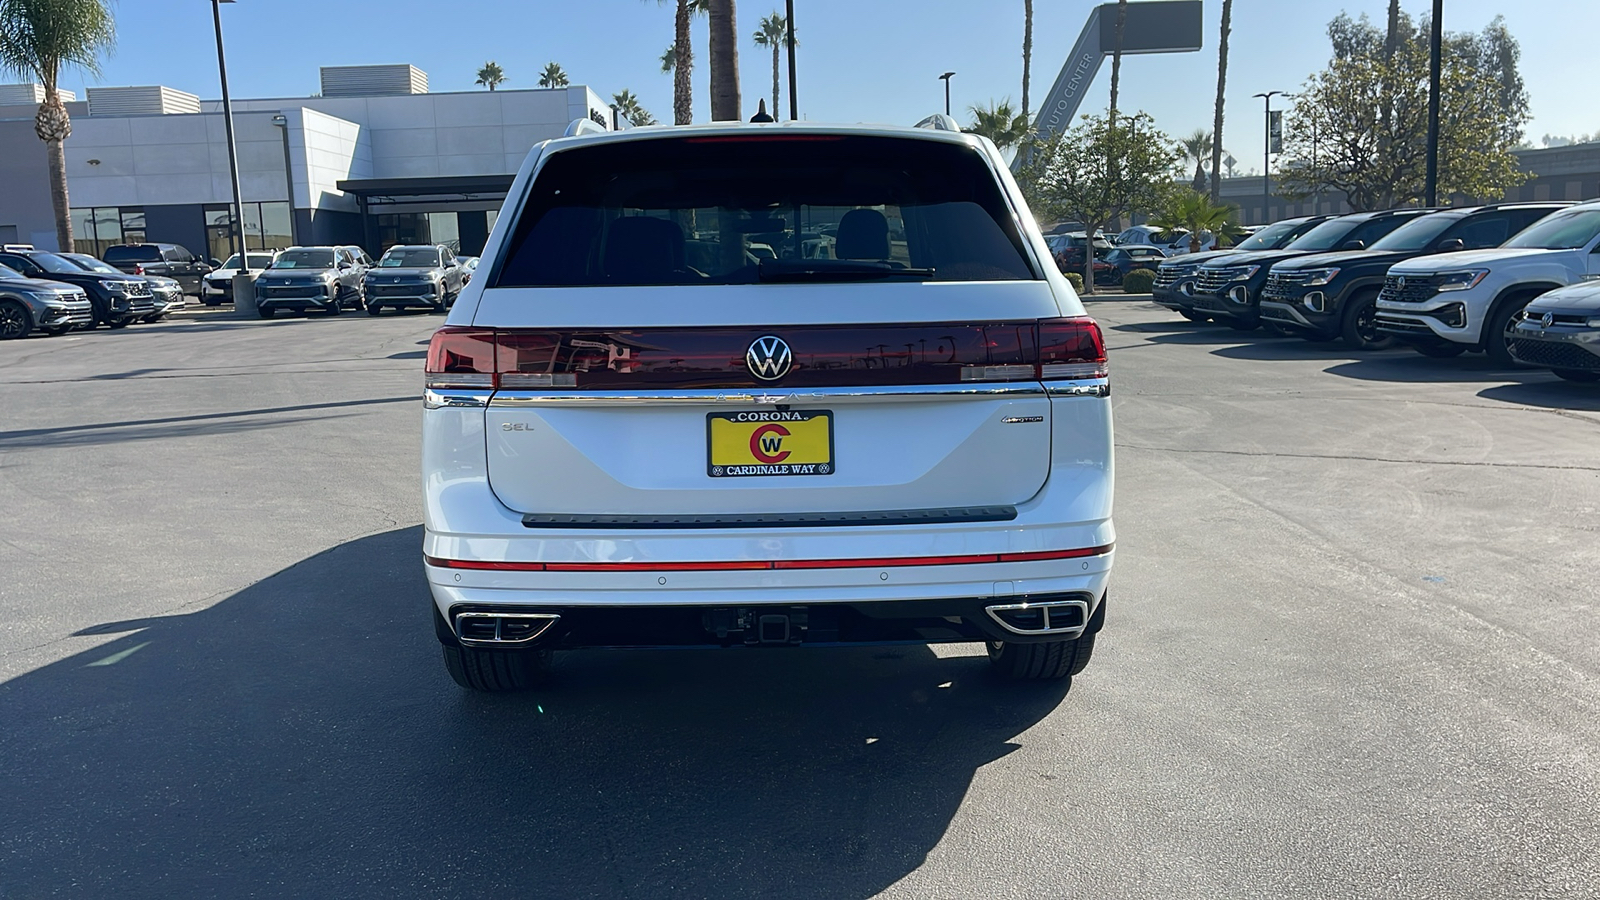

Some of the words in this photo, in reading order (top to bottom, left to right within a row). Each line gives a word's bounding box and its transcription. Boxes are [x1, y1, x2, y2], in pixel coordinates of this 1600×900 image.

[1046, 100, 1068, 134] AUTO
[1064, 53, 1093, 98] CENTER
[737, 412, 802, 421] CORONA
[501, 422, 535, 432] SEL
[726, 465, 789, 475] CARDINALE
[791, 464, 816, 474] WAY
